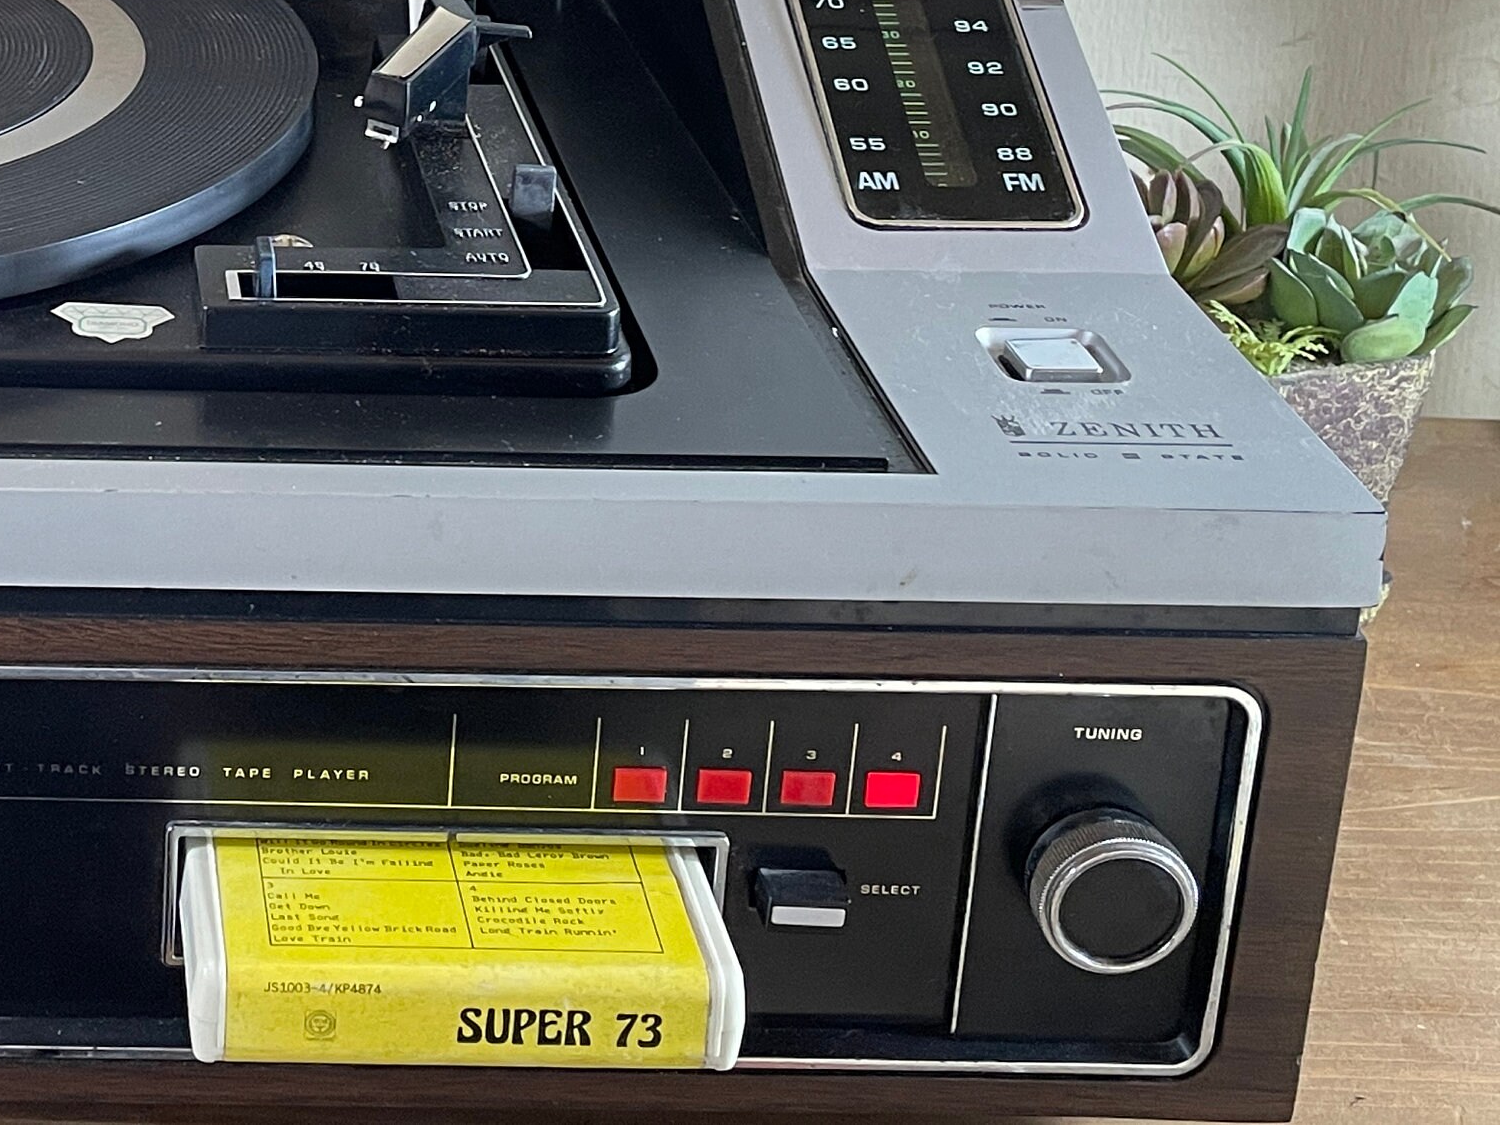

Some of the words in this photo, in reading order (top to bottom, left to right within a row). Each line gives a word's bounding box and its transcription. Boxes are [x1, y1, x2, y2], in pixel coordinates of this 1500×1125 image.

[954, 20, 988, 32] 94
[822, 37, 856, 49] 65
[968, 62, 1004, 74] 92
[833, 78, 869, 91] 60
[982, 103, 1017, 116] 90
[850, 138, 885, 150] 55
[997, 148, 1032, 160] 88
[858, 171, 899, 190] AM
[1003, 173, 1045, 191] FM
[466, 252, 509, 262] AUTO
[1051, 421, 1222, 439] ZENITH
[1074, 727, 1143, 740] TUNING
[722, 748, 733, 759] 2
[806, 750, 817, 760] 3
[891, 751, 902, 761] 4
[125, 764, 201, 777] STEREO
[222, 767, 272, 779] TAPE
[293, 768, 370, 781] PLAYER
[500, 773, 578, 786] PROGRAM
[262, 847, 312, 855] Brother
[263, 857, 300, 865] Could
[860, 884, 921, 896] SELECT
[525, 896, 570, 904] Closed
[578, 897, 617, 905] Doors
[270, 913, 300, 921] Last
[477, 916, 546, 924] Crocodile
[553, 917, 585, 925] Rock
[271, 924, 303, 932] Good
[519, 927, 558, 935] Train
[264, 982, 382, 995] JS1003-4/KP4874
[457, 1008, 592, 1046] SUPER
[615, 1013, 662, 1048] 73
